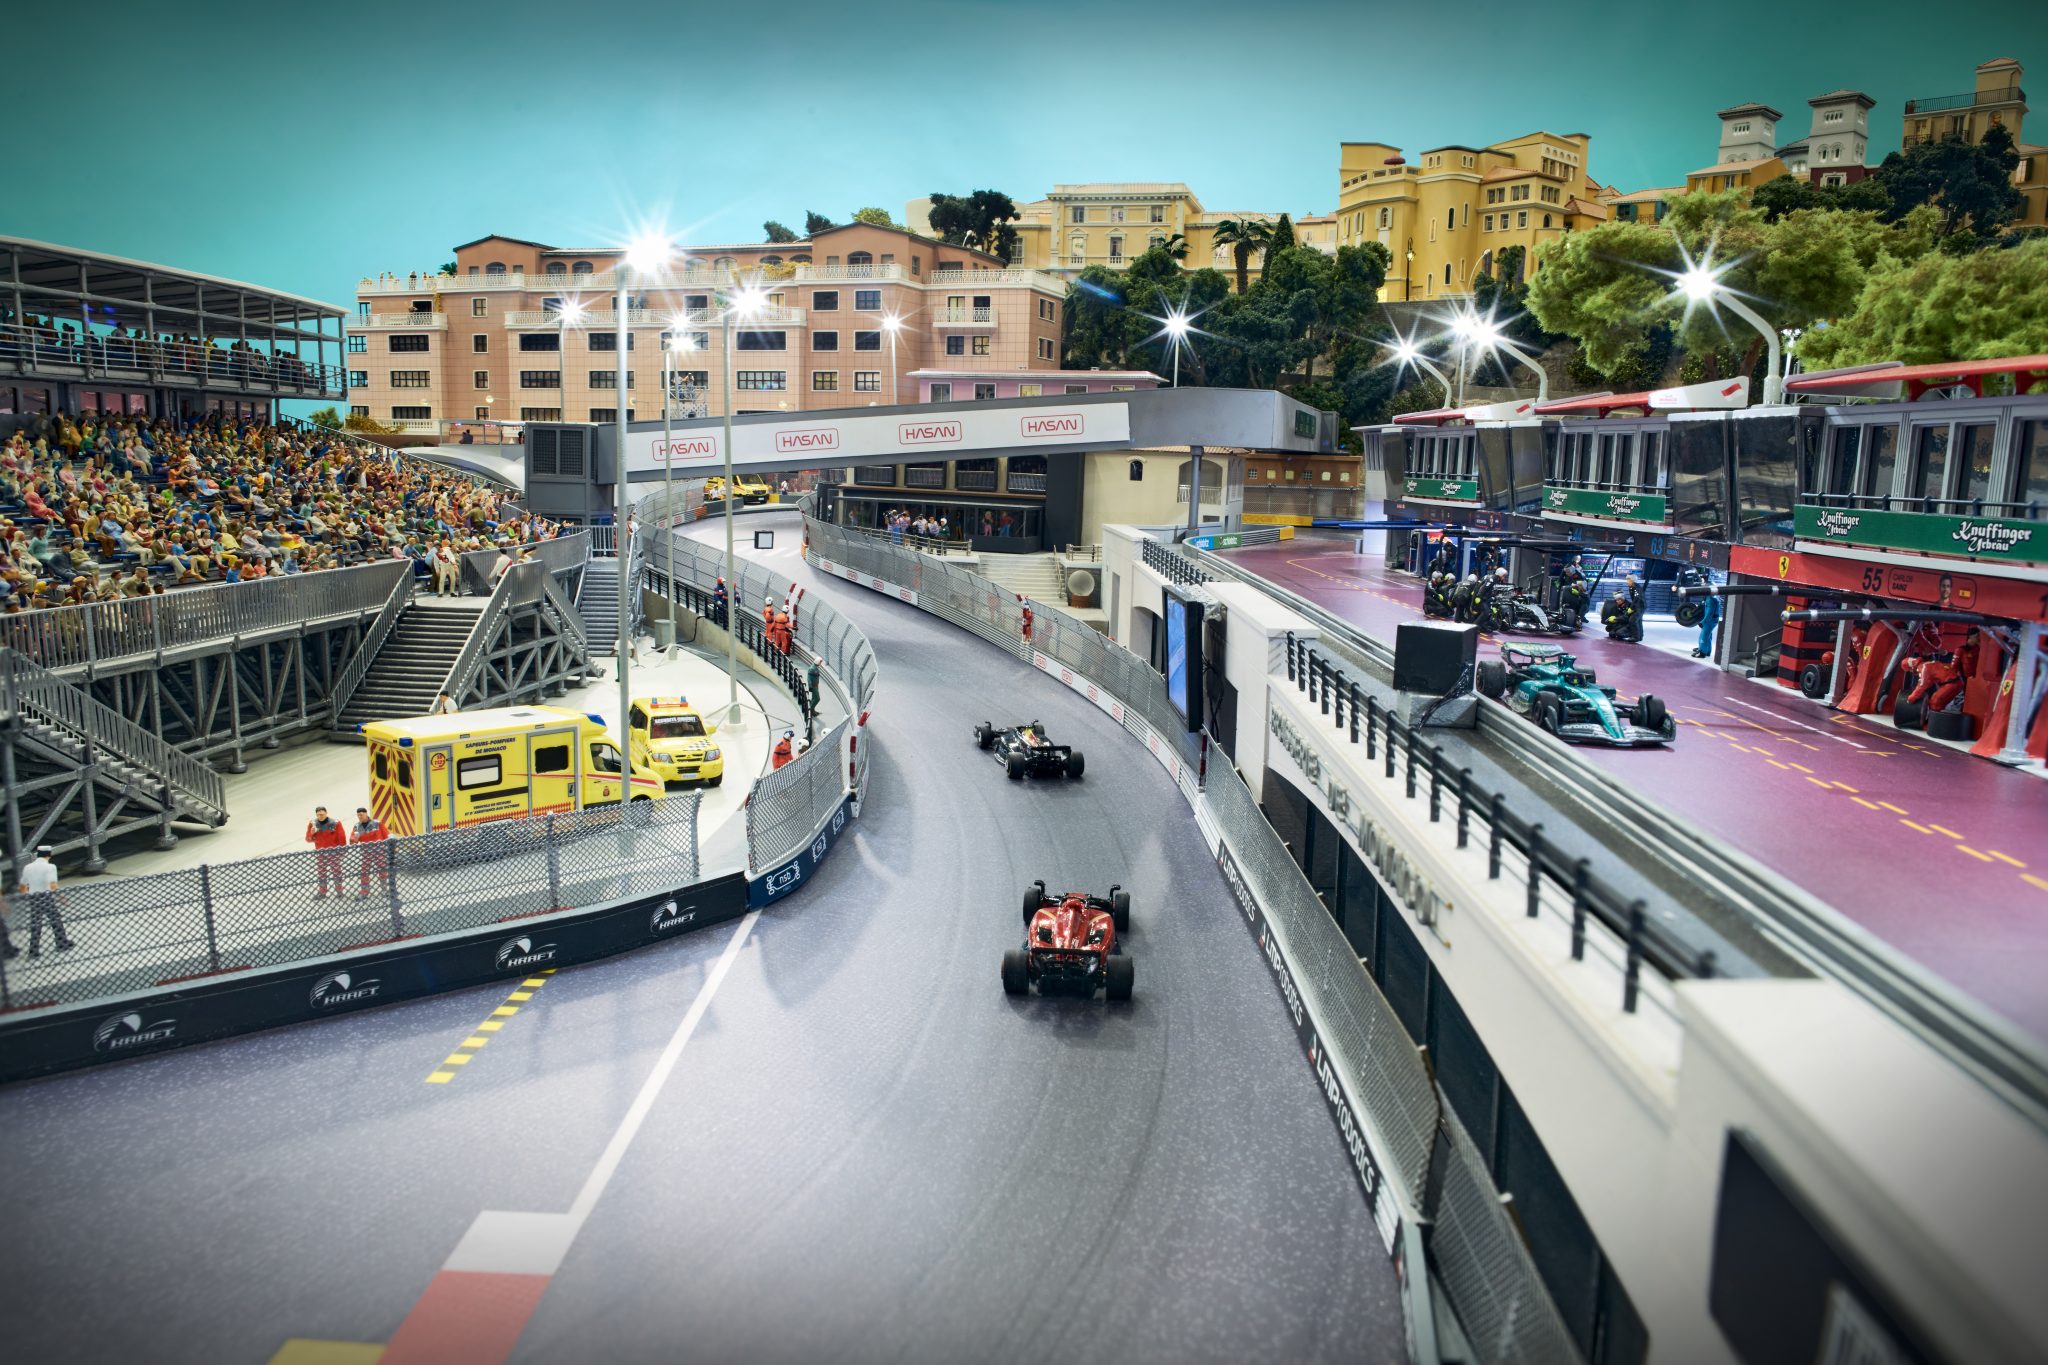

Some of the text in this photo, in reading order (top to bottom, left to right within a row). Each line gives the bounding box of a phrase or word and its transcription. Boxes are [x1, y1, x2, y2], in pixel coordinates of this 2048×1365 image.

[905, 426, 955, 440] HASAN
[1028, 419, 1077, 433] HASAN
[782, 433, 832, 447] HASAN
[1817, 511, 1860, 527] Knuffinger
[1953, 521, 2032, 545] Knuffinger
[1651, 537, 1663, 555] 63
[1862, 567, 1883, 592] 55
